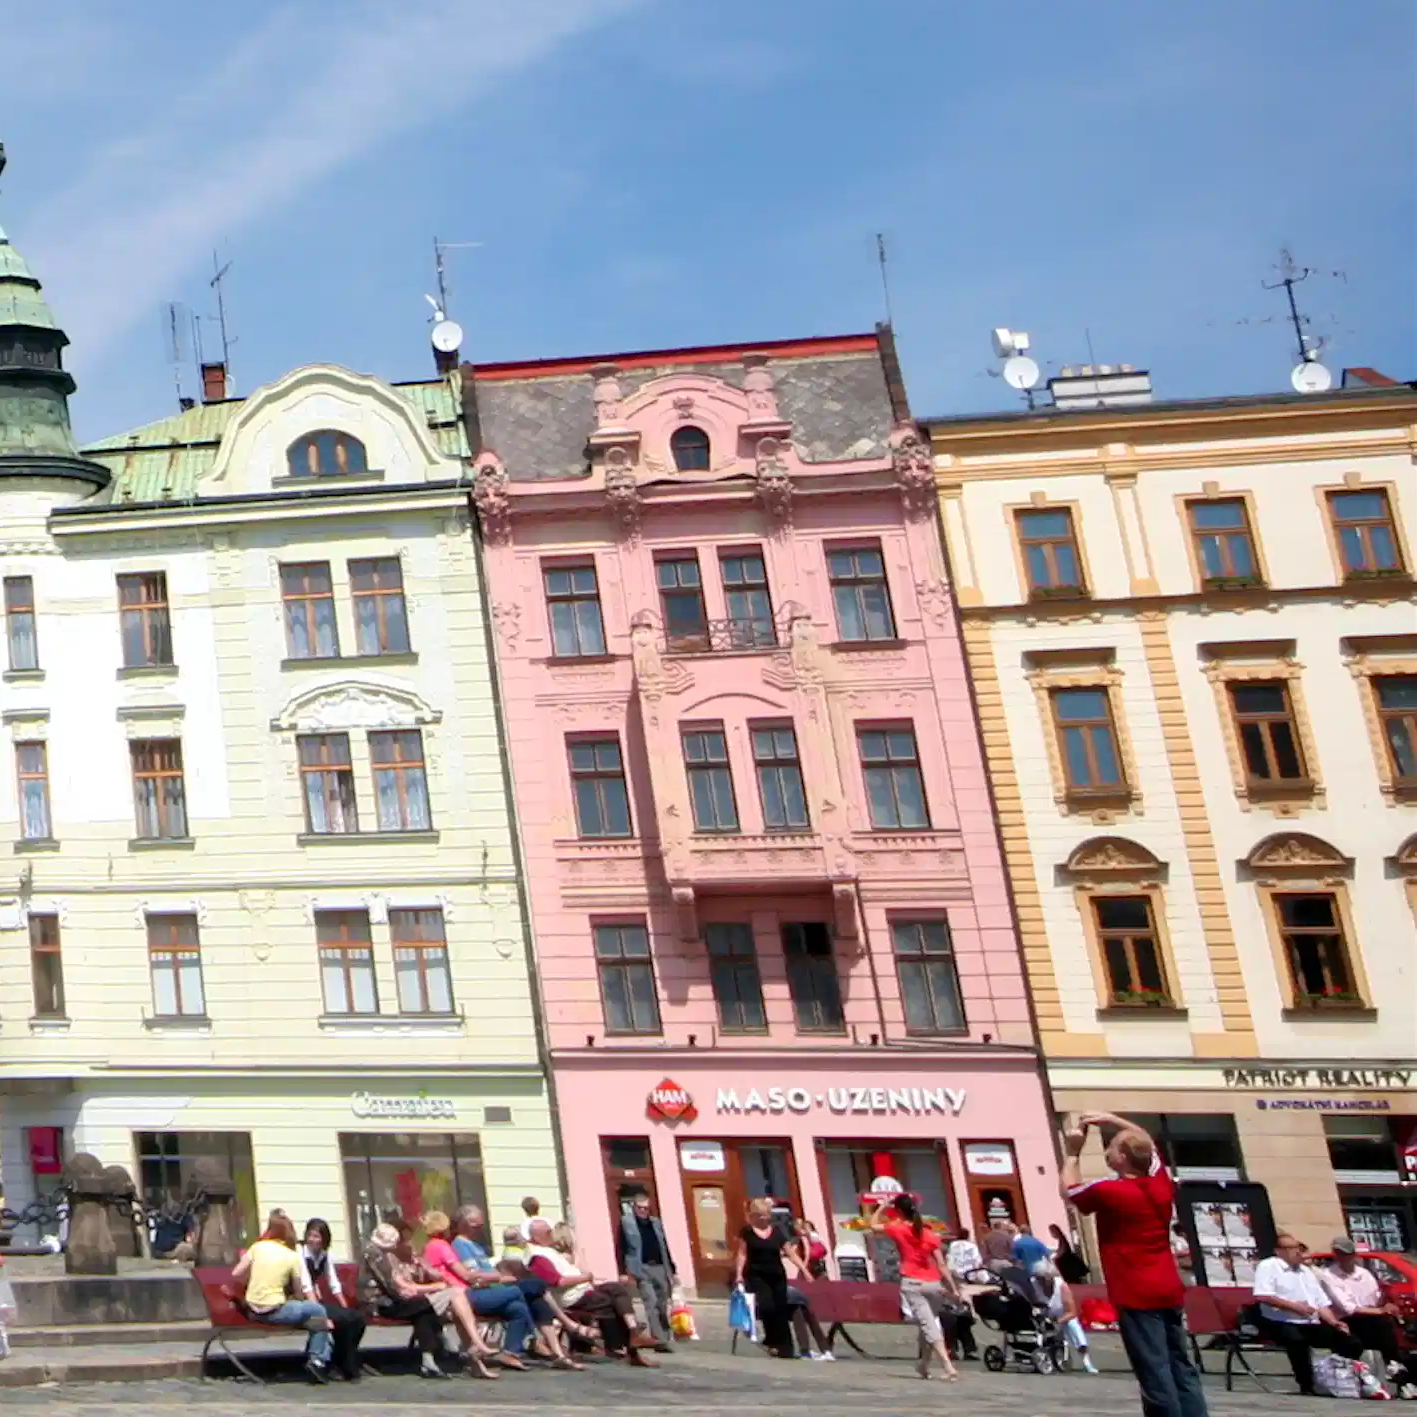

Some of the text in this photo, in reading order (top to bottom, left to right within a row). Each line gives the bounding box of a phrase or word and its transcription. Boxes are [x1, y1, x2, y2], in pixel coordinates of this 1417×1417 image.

[1222, 1069, 1414, 1088] PATRIOT REALITY
[652, 1089, 689, 1107] HAM
[716, 1086, 967, 1115] MASO UZENINY
